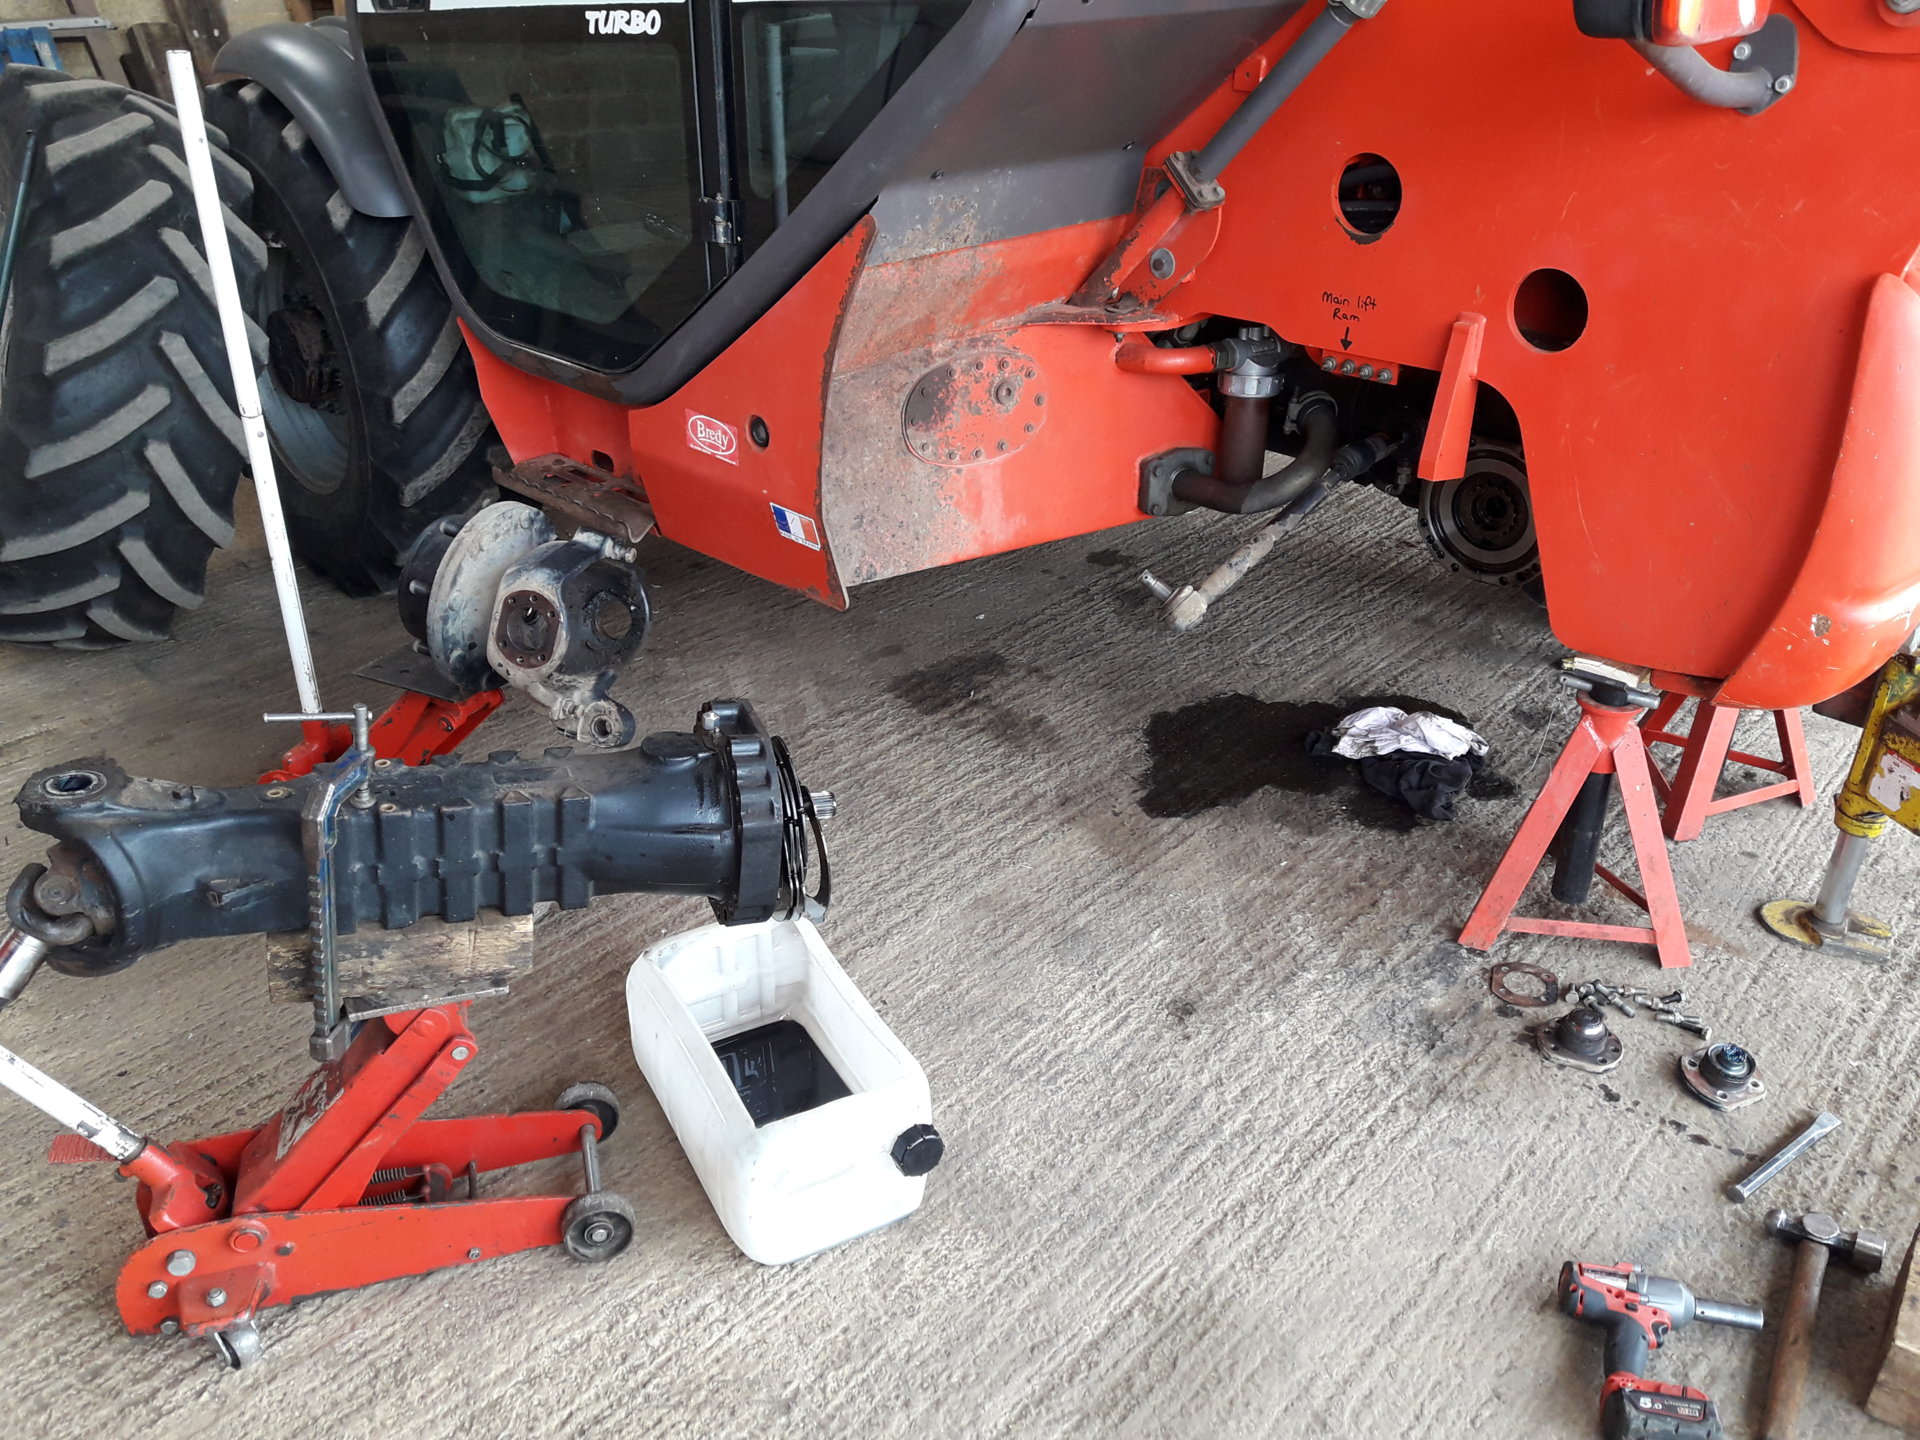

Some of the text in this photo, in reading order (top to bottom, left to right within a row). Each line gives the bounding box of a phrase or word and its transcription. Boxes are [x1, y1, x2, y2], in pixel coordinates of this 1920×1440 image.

[585, 9, 661, 35] TURBO
[1322, 291, 1377, 311] Main lift
[1333, 307, 1360, 322] Ram
[696, 419, 729, 450] Bredy
[1639, 1396, 1663, 1410] 5.0
